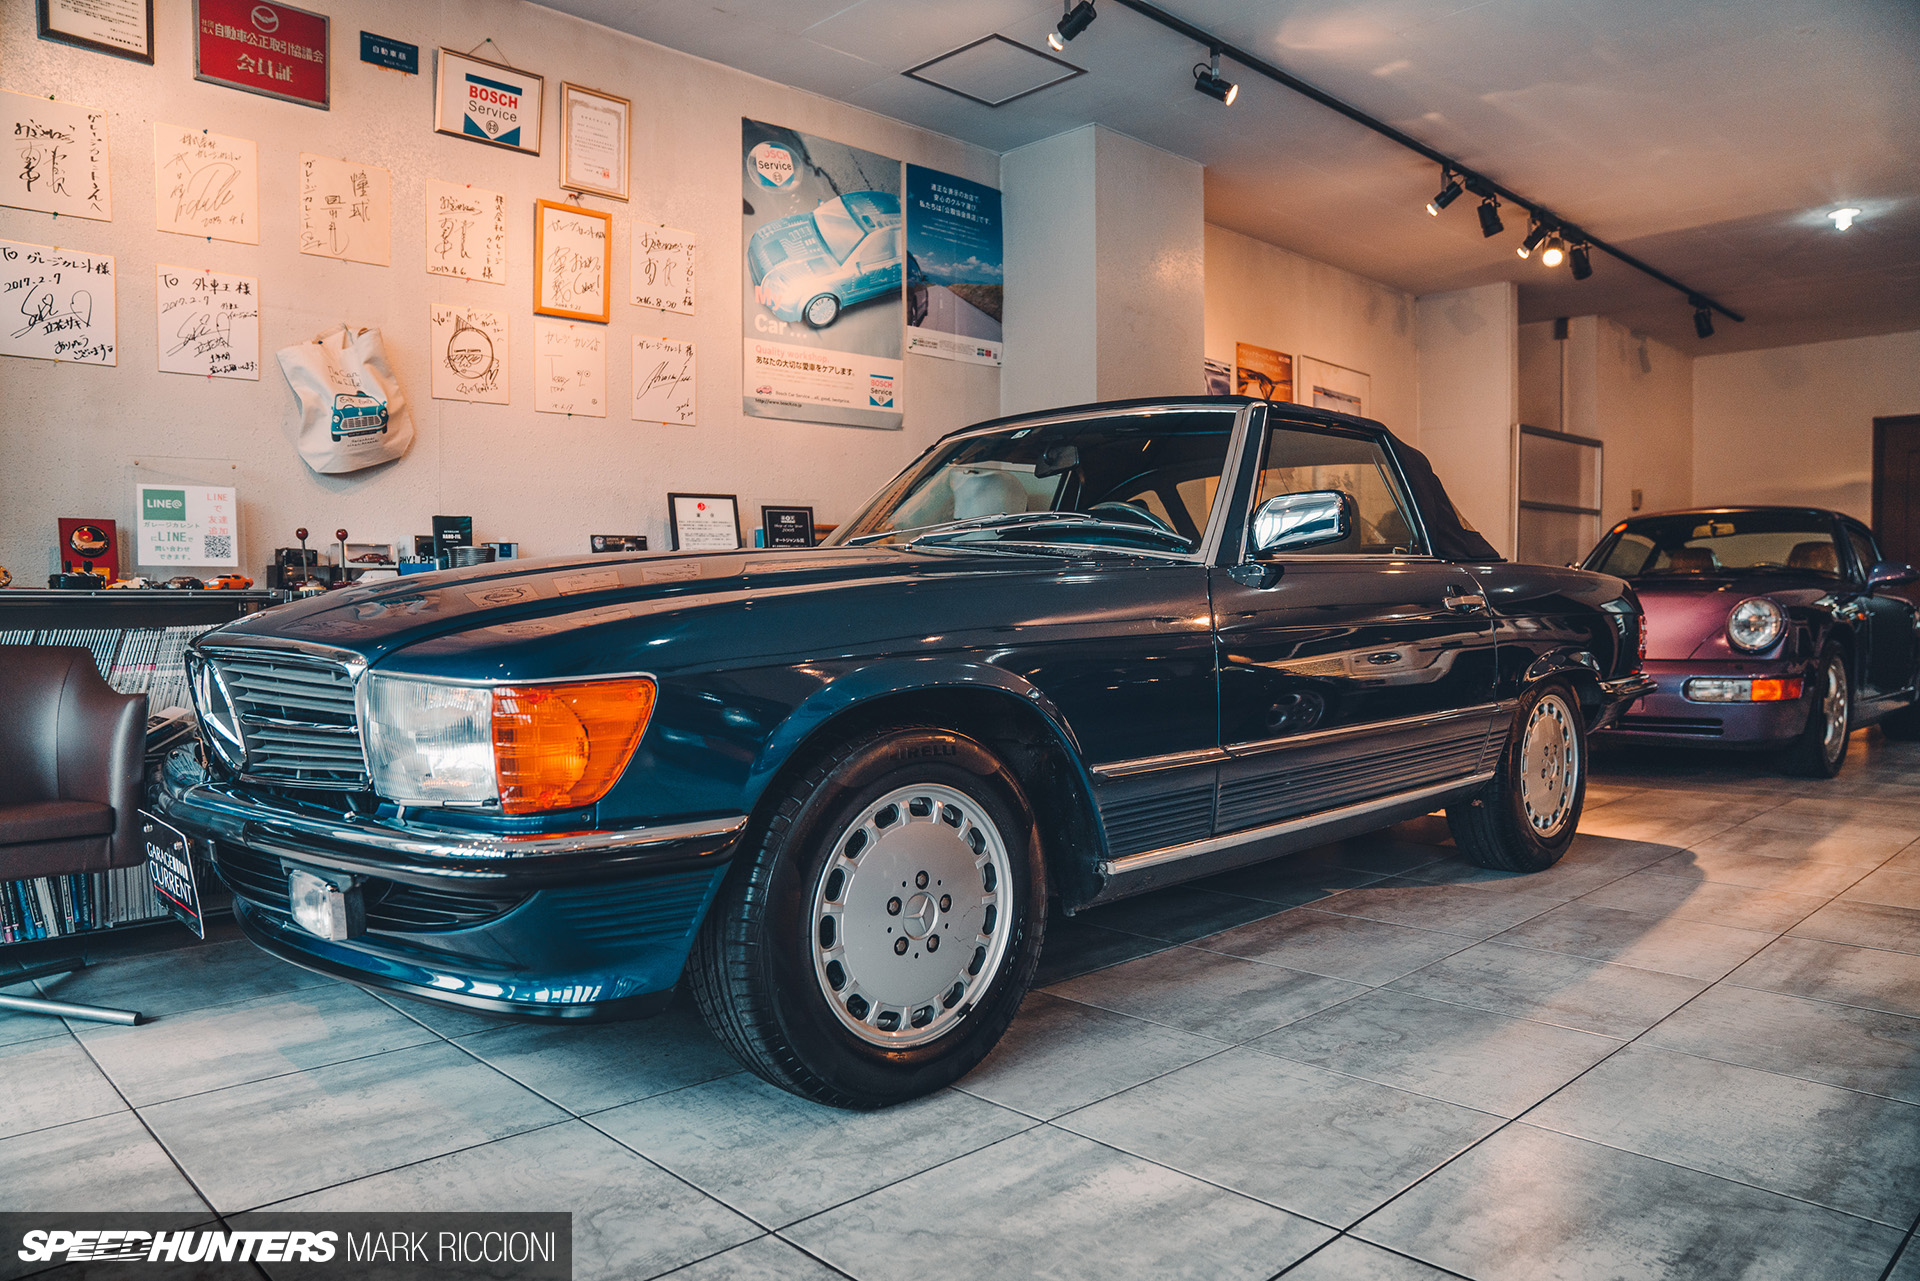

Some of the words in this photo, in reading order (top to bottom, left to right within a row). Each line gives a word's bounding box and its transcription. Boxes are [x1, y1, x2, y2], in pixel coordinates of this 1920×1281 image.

[214, 22, 324, 64] 自動車公正取引協議会
[236, 53, 294, 83] 会員証
[469, 84, 518, 110] BOSCH
[468, 100, 517, 122] Service
[763, 149, 790, 161] OSCH
[758, 160, 792, 171] Service
[159, 273, 179, 289] TO
[755, 344, 785, 358] Quality
[870, 379, 893, 389] BOSCH
[870, 387, 893, 397] Service
[206, 493, 228, 501] LINE
[146, 499, 183, 509] LINE@
[214, 505, 223, 513] で
[144, 521, 200, 529] ガレージカレント
[208, 515, 228, 525] 友達
[208, 527, 228, 535] 追加
[150, 860, 192, 906] CURRENT
